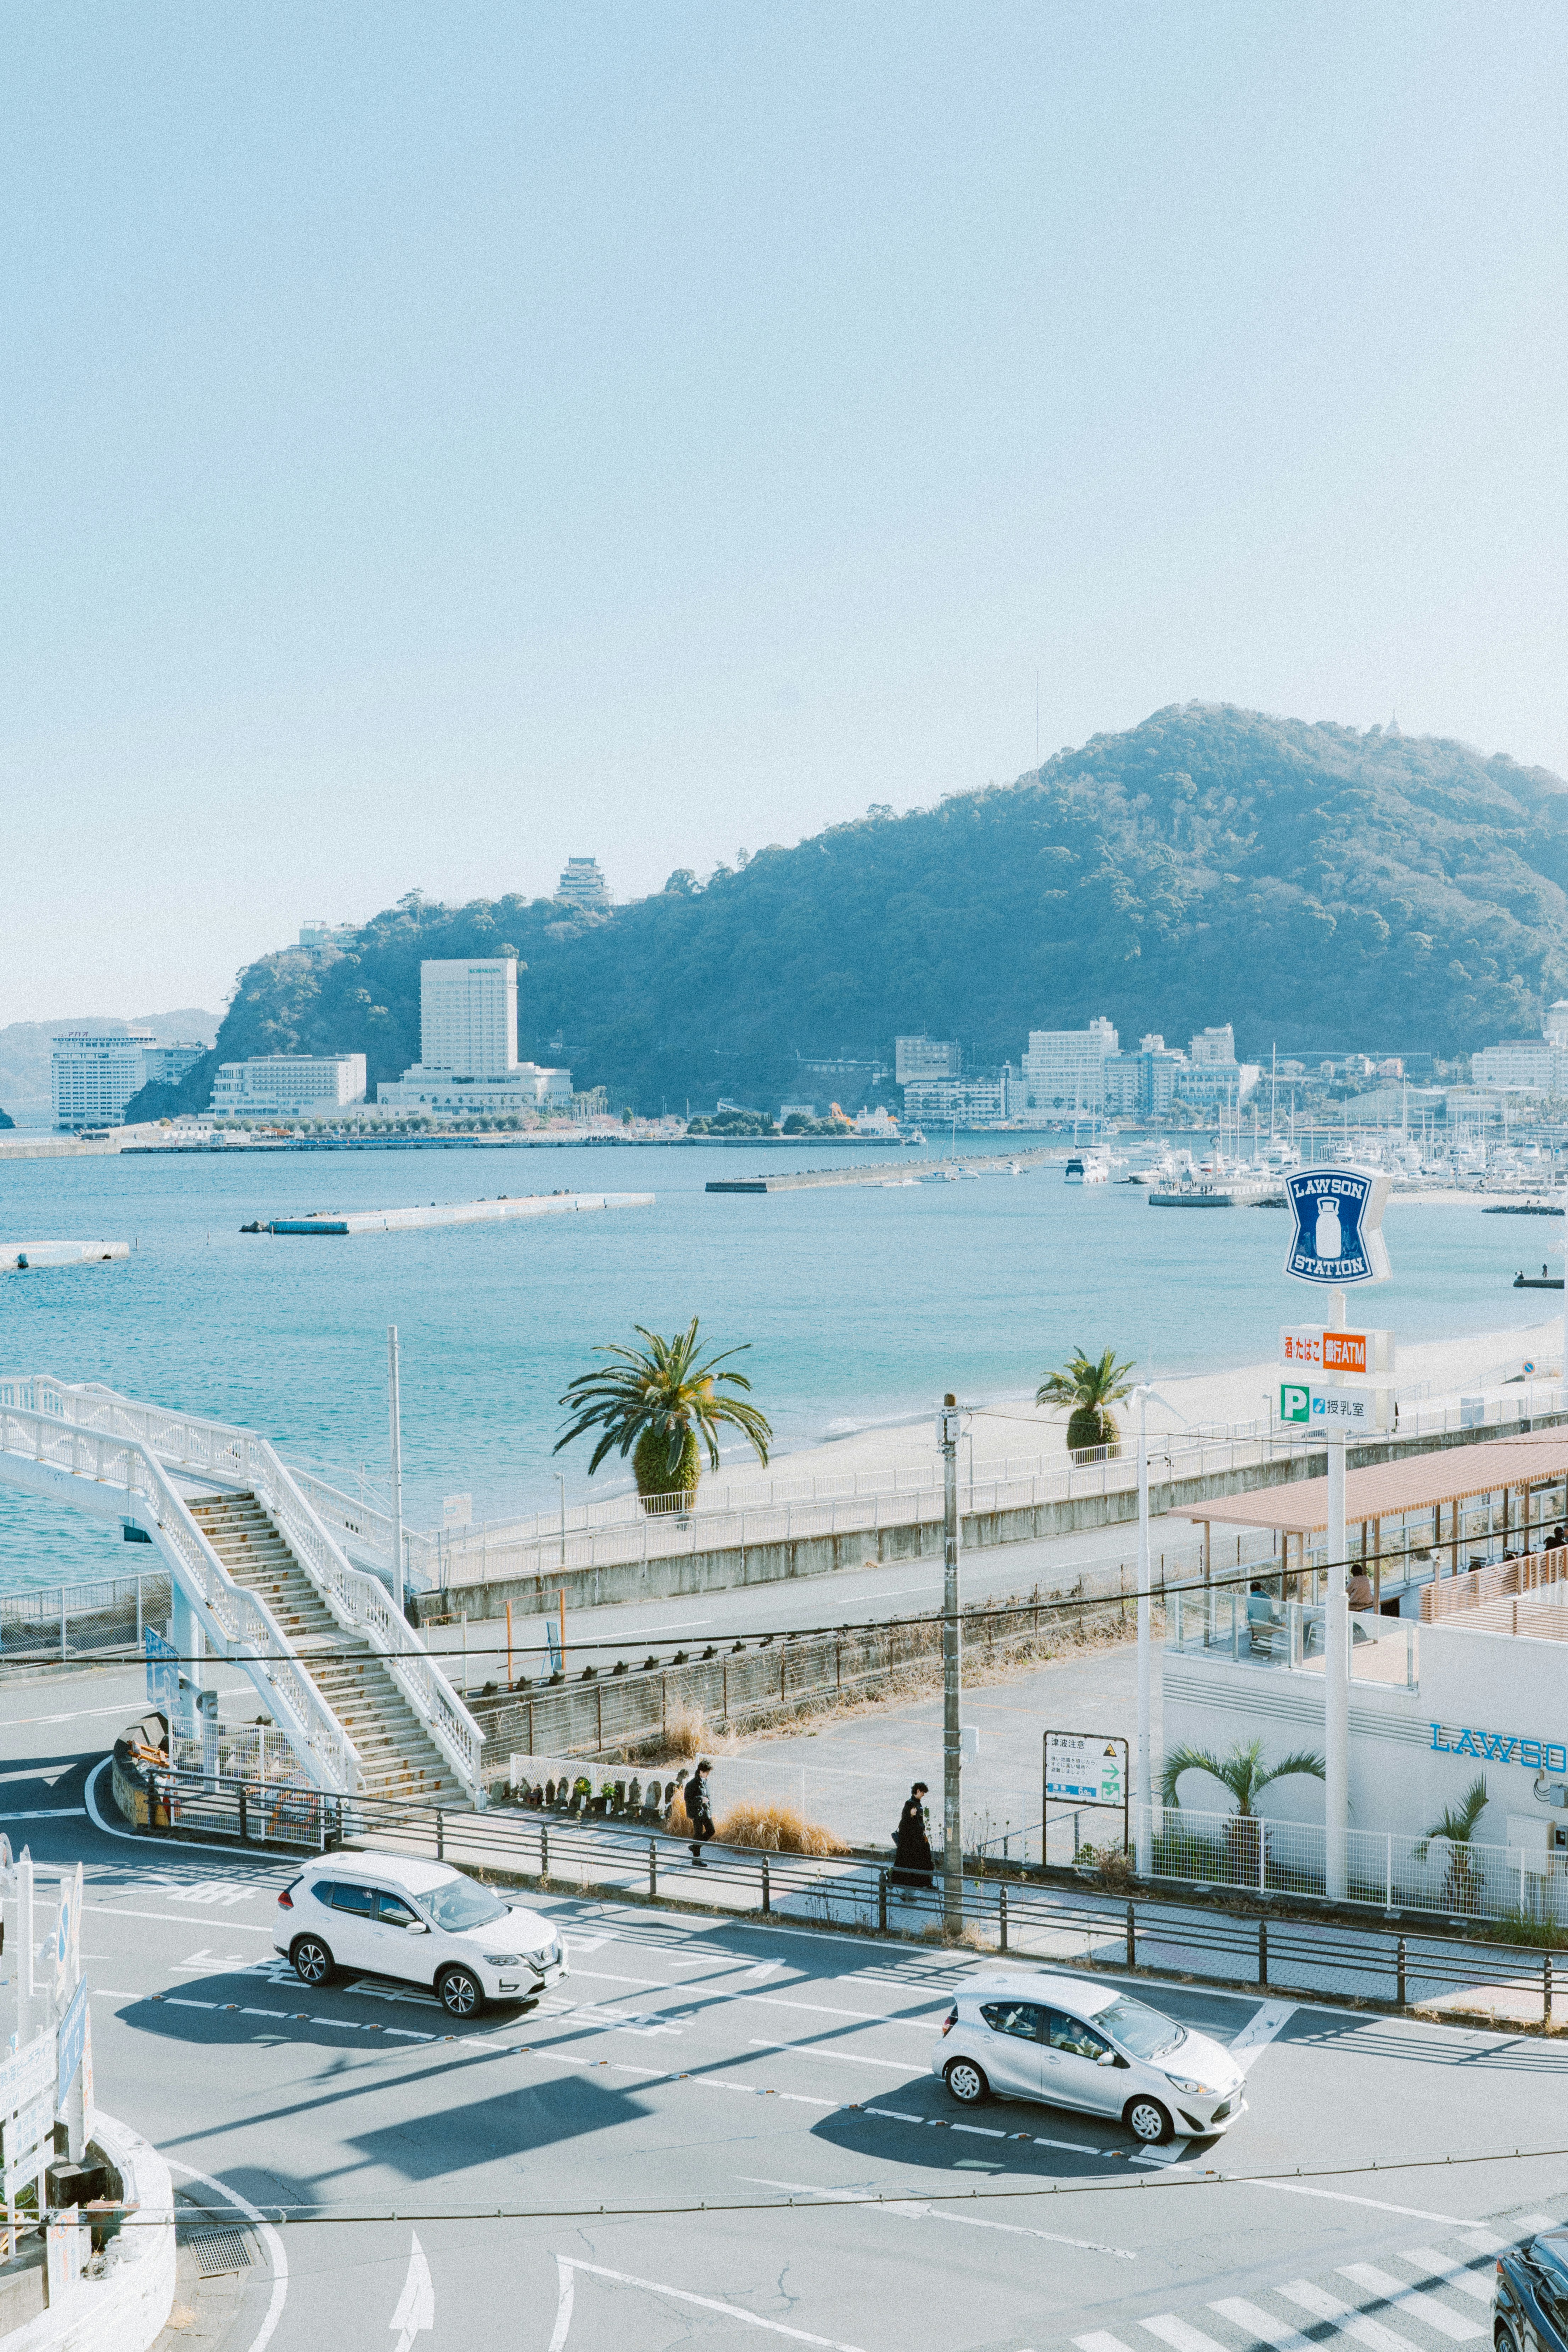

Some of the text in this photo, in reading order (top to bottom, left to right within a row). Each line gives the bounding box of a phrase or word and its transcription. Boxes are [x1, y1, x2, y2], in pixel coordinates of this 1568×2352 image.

[1293, 1178, 1364, 1199] LAWSON
[1294, 1254, 1365, 1276] STATION
[1325, 1339, 1364, 1365] 銀行ATM
[1284, 1388, 1307, 1418] P
[1327, 1400, 1364, 1416] 授乳室
[1051, 1737, 1085, 1749] 津波注意
[1430, 1723, 1567, 1773] LAWSO
